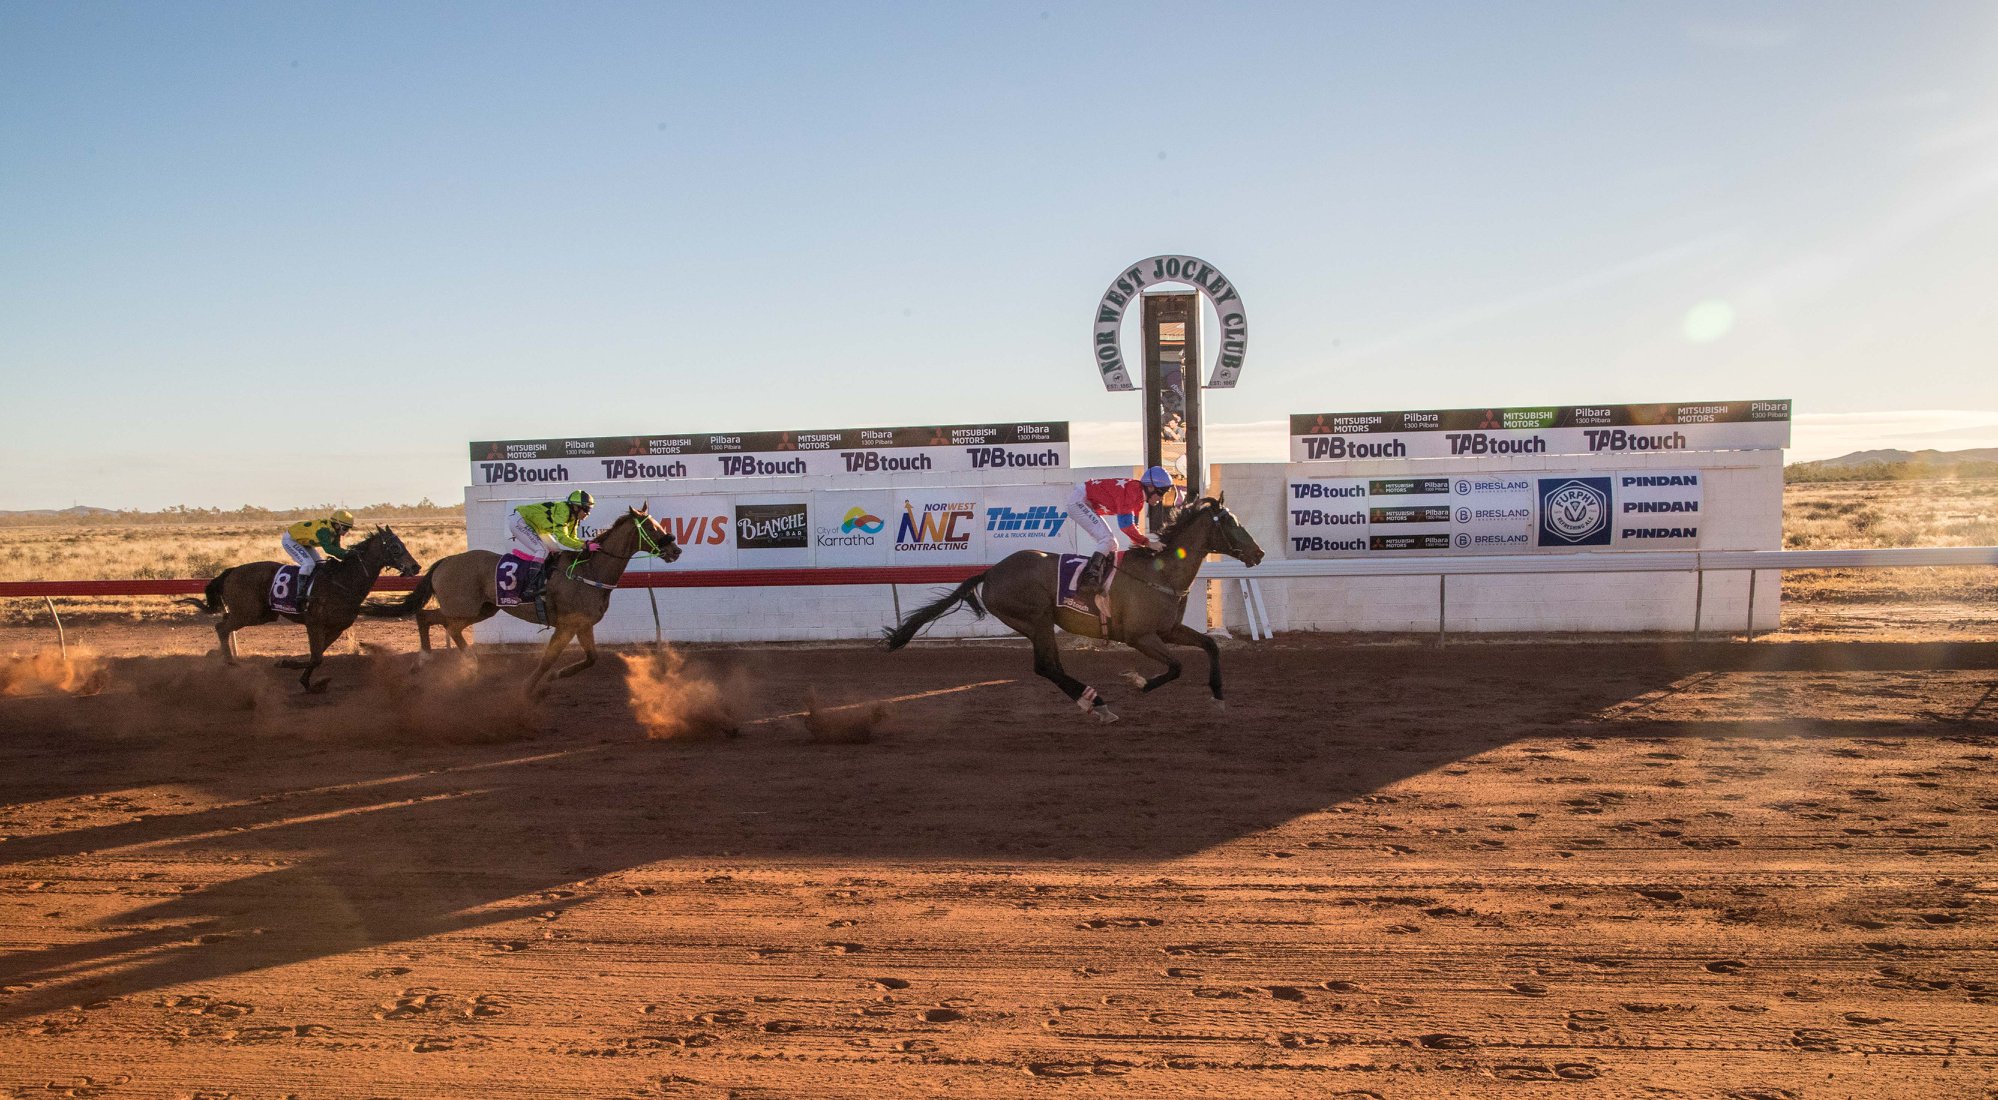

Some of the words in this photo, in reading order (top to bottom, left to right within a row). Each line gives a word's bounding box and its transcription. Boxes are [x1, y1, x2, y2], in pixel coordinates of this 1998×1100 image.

[1154, 258, 1237, 306] JOCKEY
[1098, 266, 1146, 323] WEST
[1221, 313, 1244, 369] CLUB
[1096, 330, 1122, 375] NOR
[1678, 406, 1728, 415] MITSUBISHI
[1752, 402, 1788, 411] Pilbara
[1504, 412, 1552, 421] MITSUBISHI
[1576, 408, 1610, 416] Pilbara
[1334, 416, 1382, 425] MITSUBISHI
[1404, 413, 1438, 422] Pilbara
[1678, 414, 1714, 423] MOTORS
[1504, 420, 1540, 428] MOTORS
[861, 430, 892, 440] Pilbara
[952, 428, 996, 437] MITSUBISHI
[1018, 426, 1050, 434] Pilbara
[650, 438, 691, 447] MITSUBISHI
[710, 436, 740, 444] Pilbara
[798, 434, 841, 442] MITSUBISHI
[952, 436, 985, 444] MOTORS
[1584, 430, 1686, 452] TABtouch
[506, 444, 547, 452] MITSUBISHI
[566, 440, 594, 448] Pilbara
[1302, 437, 1406, 459] TABtouch
[1446, 434, 1546, 455] TABtouch
[650, 446, 680, 454] MOTORS
[841, 452, 932, 472] TABtouch
[967, 448, 1059, 468] TABtouch
[602, 460, 686, 479] TABtouch
[718, 456, 806, 475] TABtouch
[480, 462, 568, 483] TABtouch
[1475, 482, 1528, 490] BRESLAND
[1622, 476, 1698, 487] PINDAN
[1291, 484, 1366, 498] TABtouch
[1556, 491, 1596, 507] FURPHY
[924, 502, 976, 512] NORWEST
[1624, 501, 1698, 513] PINDAN
[1291, 510, 1366, 526] TABtouch
[1476, 509, 1530, 518] BRESLAND
[737, 512, 806, 540] BLANCHE
[986, 506, 1068, 538] Thrifty
[817, 526, 830, 536] City
[832, 526, 839, 534] of
[1622, 528, 1697, 538] PINDAN
[817, 534, 874, 546] Karratha
[1292, 536, 1366, 551] TABtouch
[1475, 534, 1528, 543] BRESLAND
[894, 542, 968, 552] CONTRACTING
[499, 562, 518, 590] 3
[1066, 558, 1088, 590] 7
[273, 572, 290, 598] 8
